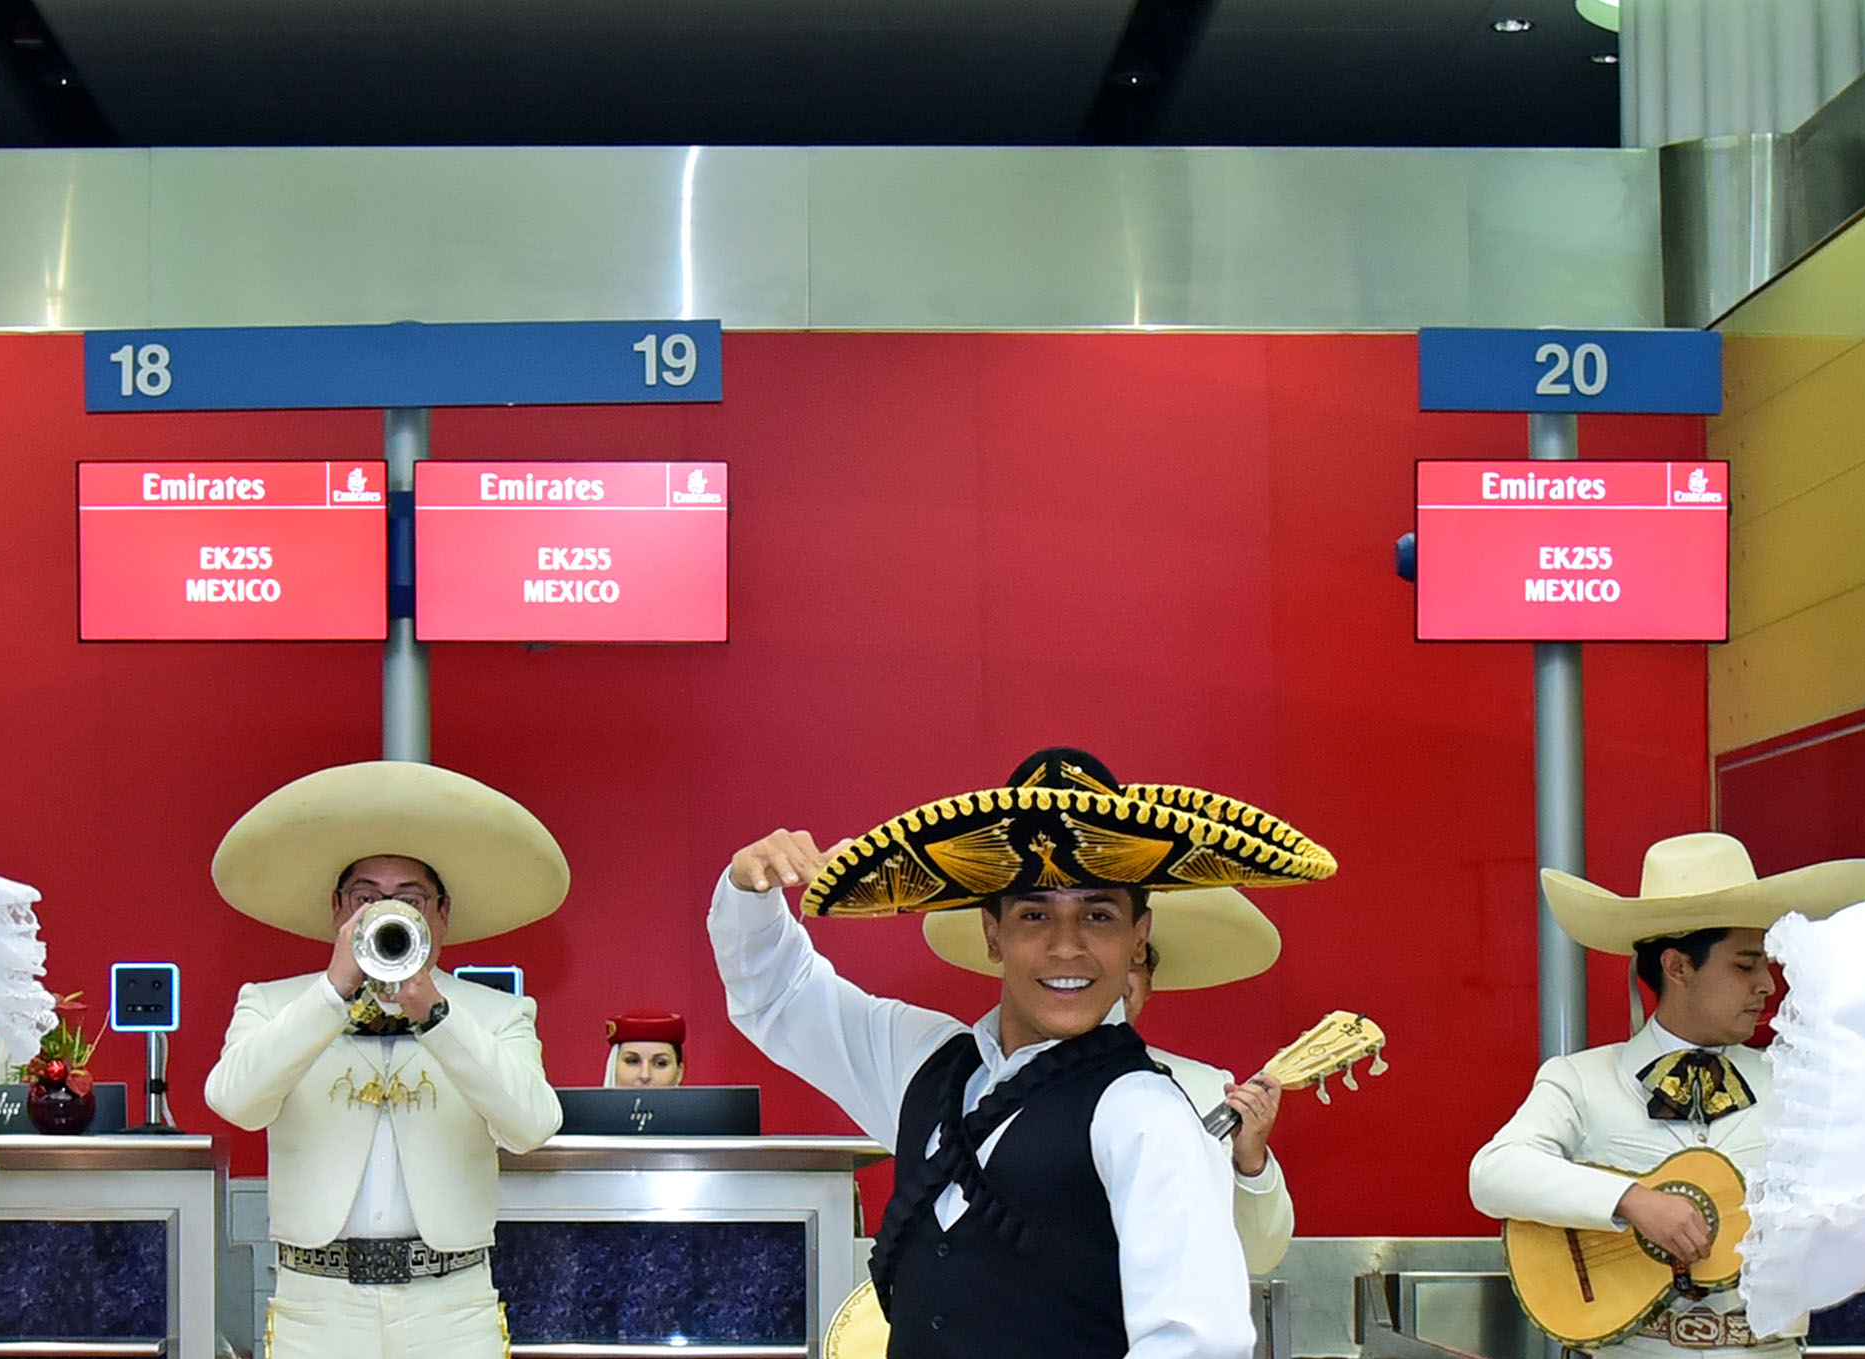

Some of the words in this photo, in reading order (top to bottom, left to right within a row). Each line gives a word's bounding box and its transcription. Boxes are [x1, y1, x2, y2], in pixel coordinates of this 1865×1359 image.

[110, 344, 172, 397] 18
[633, 333, 698, 387] 19
[1535, 343, 1608, 397] 20
[142, 472, 266, 501] Emirates
[480, 472, 605, 501] Emirates
[1482, 472, 1606, 500] Emirates
[199, 547, 273, 570] EK255
[538, 547, 612, 571] EK255
[1539, 546, 1613, 570] EK255
[186, 579, 281, 602] MEXICO
[523, 579, 620, 603] MEXICO
[1525, 579, 1621, 602] MEXICO
